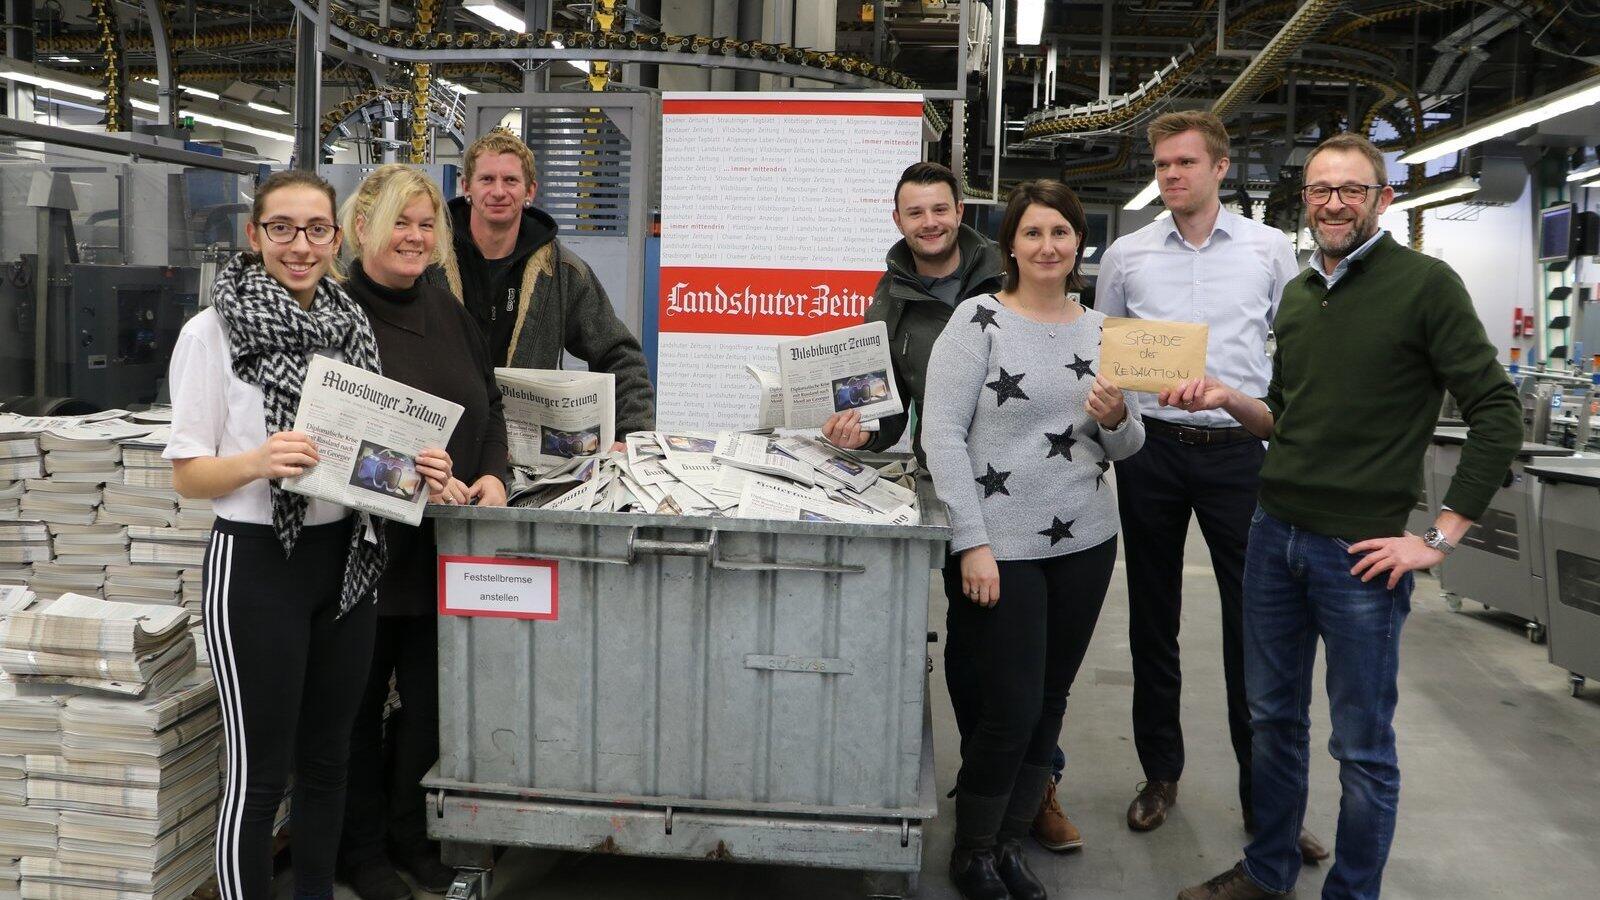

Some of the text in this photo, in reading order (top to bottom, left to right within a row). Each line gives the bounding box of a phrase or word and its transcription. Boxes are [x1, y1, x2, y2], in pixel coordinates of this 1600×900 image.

[666, 281, 874, 319] Landshuter Zeitu
[1125, 330, 1184, 346] SPENDE
[790, 335, 881, 360] Vilsbiburger Zeitung
[1140, 347, 1159, 359] der
[1112, 361, 1190, 379] REDAKTION
[322, 370, 401, 411] Moosburger
[399, 397, 448, 431] Zeitung
[500, 384, 598, 409] Vilsbiburger Zeitung
[464, 572, 533, 584] Feststellbremse
[480, 593, 519, 602] anstellen
